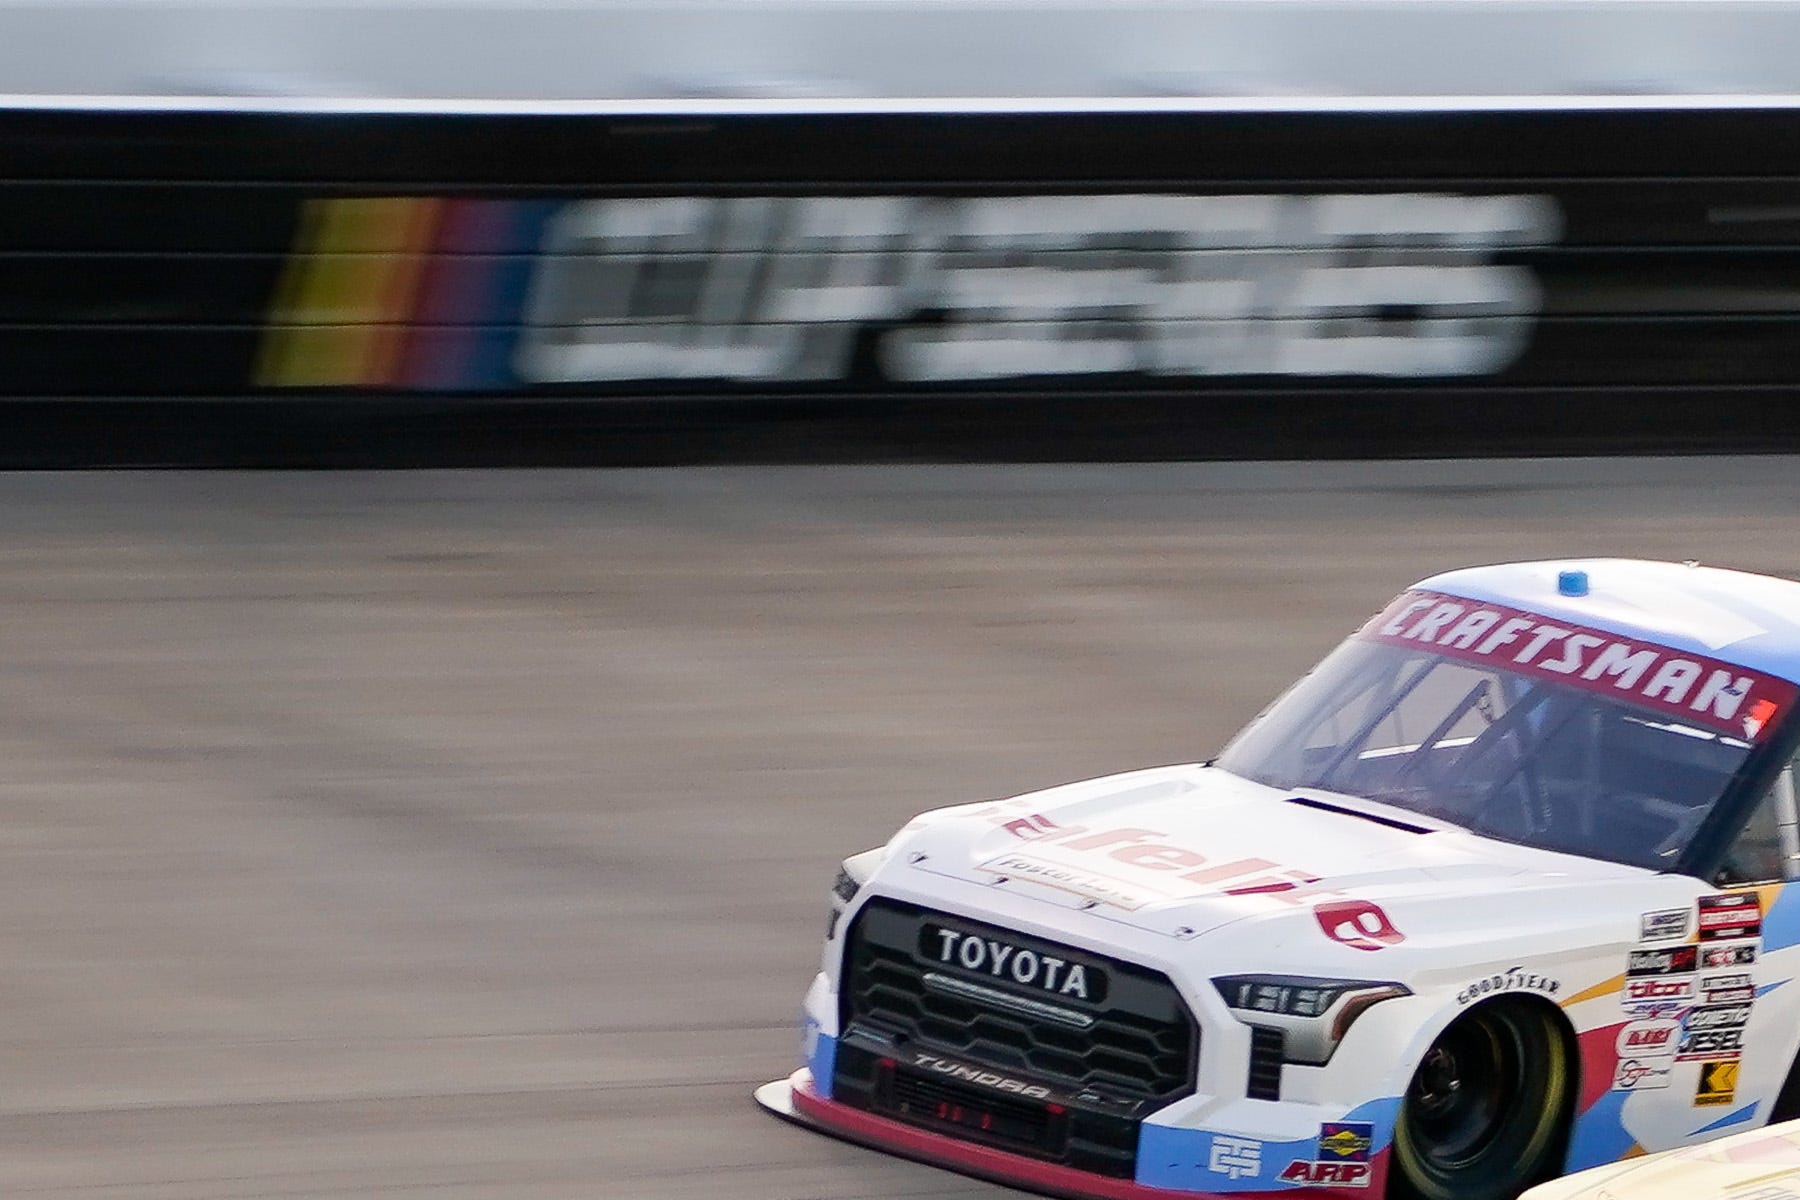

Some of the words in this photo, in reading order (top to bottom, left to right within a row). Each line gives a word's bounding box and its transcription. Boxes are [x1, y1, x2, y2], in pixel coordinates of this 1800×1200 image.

[1379, 598, 1755, 721] CRAFTSMAN
[938, 928, 1088, 999] TOYOTA
[914, 1053, 1051, 1099] TUNDRA
[1279, 1159, 1372, 1185] ARP
